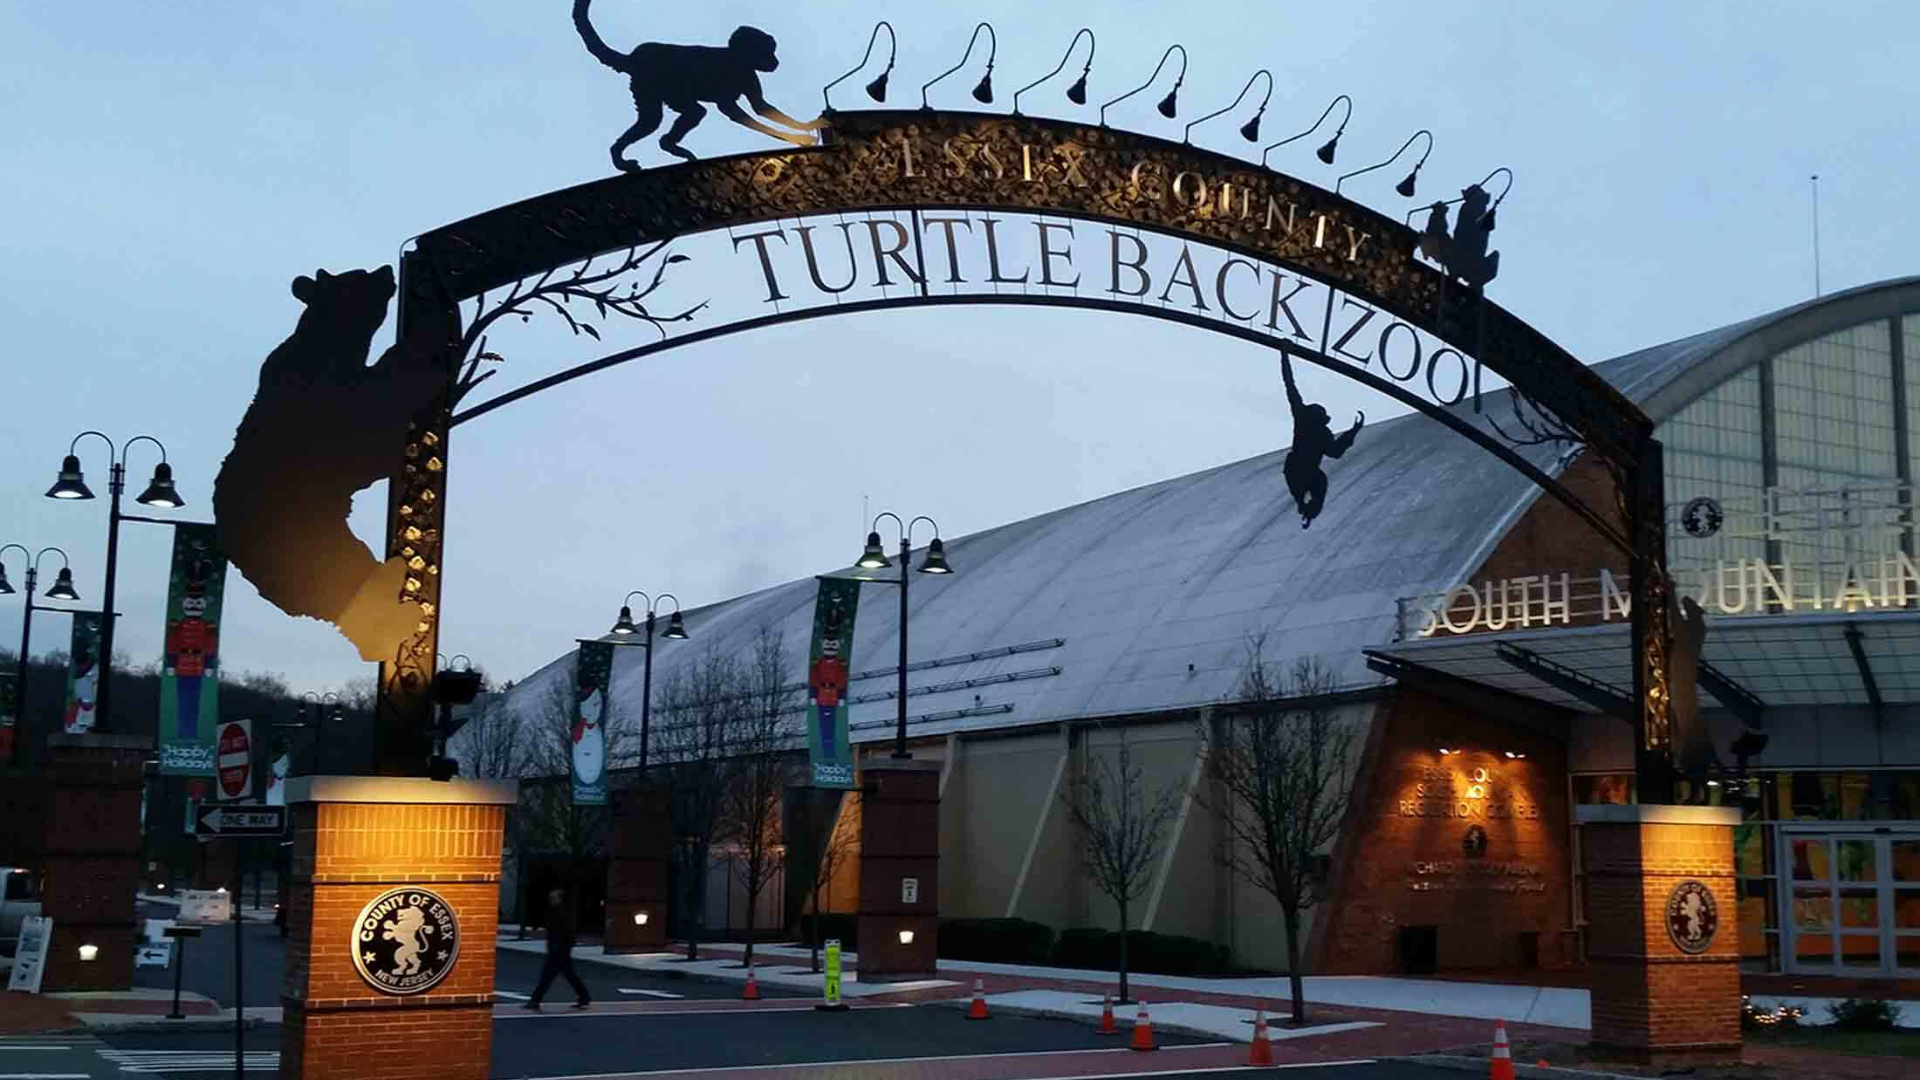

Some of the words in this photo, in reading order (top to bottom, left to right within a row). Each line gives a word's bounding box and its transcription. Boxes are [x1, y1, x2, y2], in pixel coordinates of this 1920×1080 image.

[1131, 161, 1371, 262] COUNTY
[731, 216, 1081, 303] TURTLE
[1105, 229, 1313, 342] BACK
[1331, 298, 1469, 406] ZOO
[1416, 572, 1570, 637] SOUTH
[161, 756, 214, 770] Holidays
[164, 743, 209, 758] Happy
[222, 814, 246, 827] ONE
[249, 814, 275, 827] WAY
[360, 894, 405, 942] COUNTY
[409, 894, 430, 908] OF
[429, 903, 453, 940] ESSEX
[375, 969, 399, 985] NEW
[400, 967, 433, 986] JERSEY
